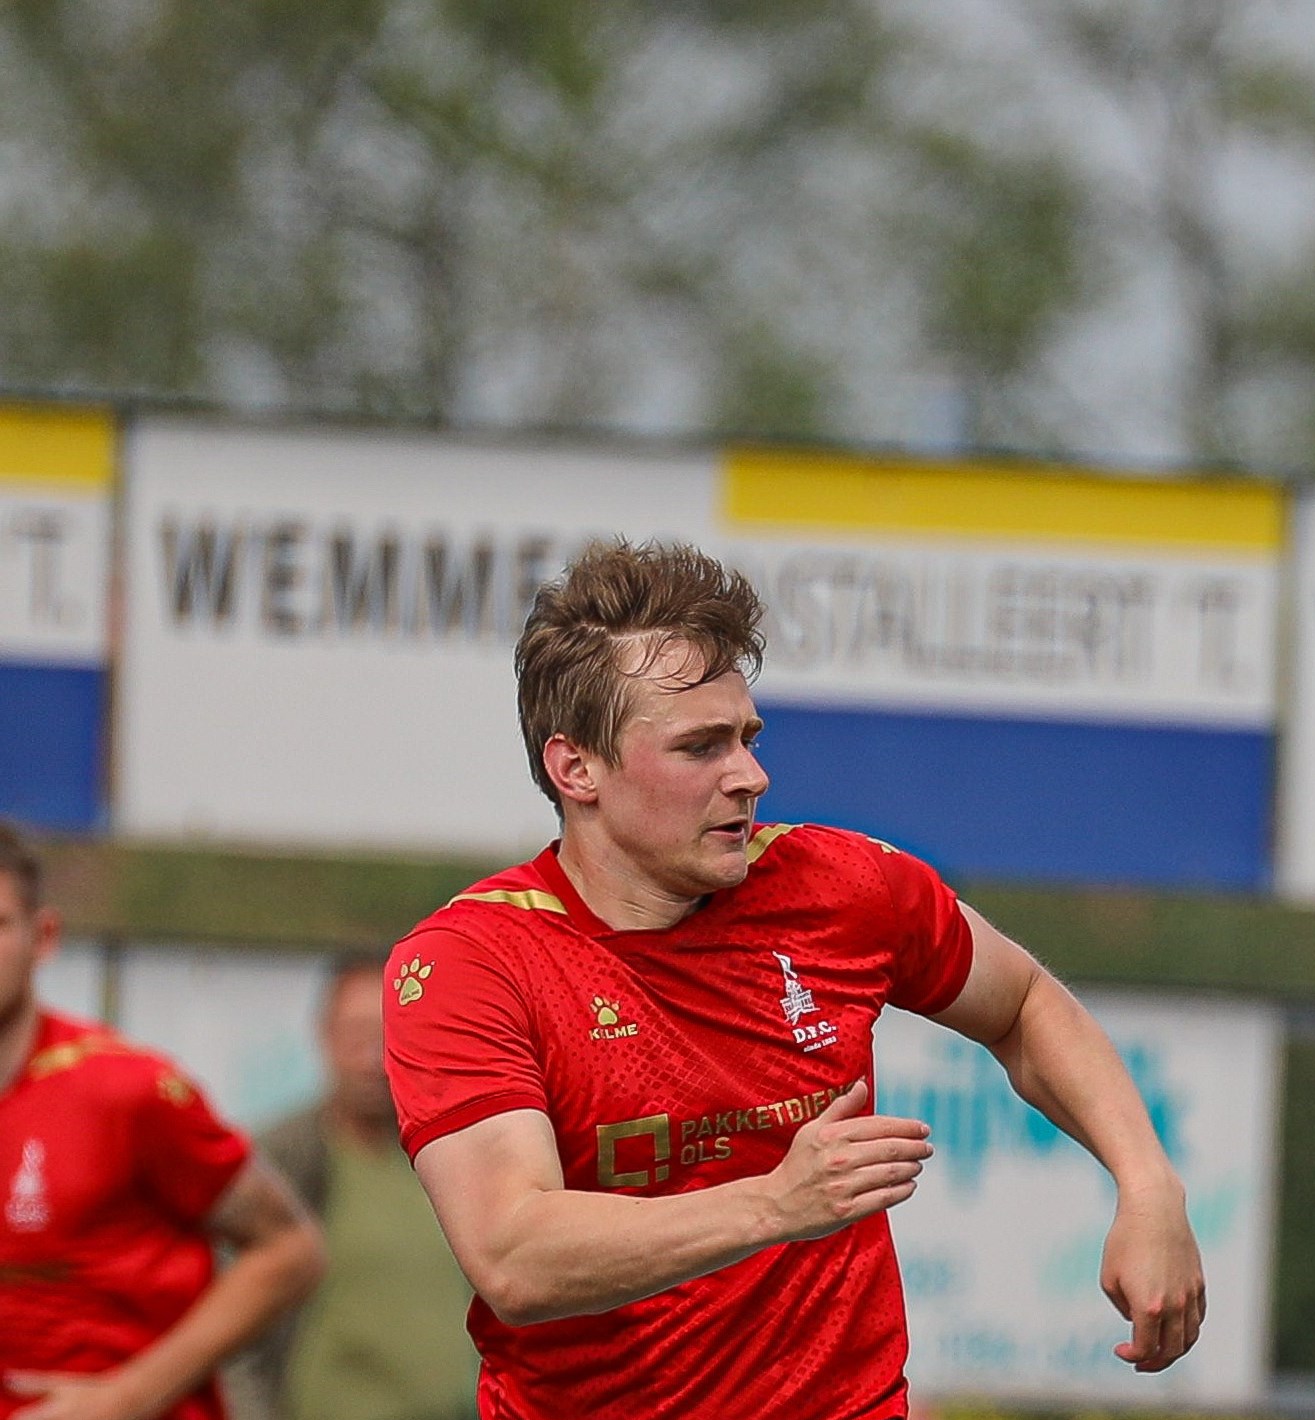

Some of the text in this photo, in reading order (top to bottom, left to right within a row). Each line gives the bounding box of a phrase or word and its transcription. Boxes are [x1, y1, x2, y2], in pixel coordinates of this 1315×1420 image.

[160, 516, 562, 636] WEMME
[681, 1074, 867, 1143] PAKKETDIEN
[680, 1136, 732, 1165] QLS
